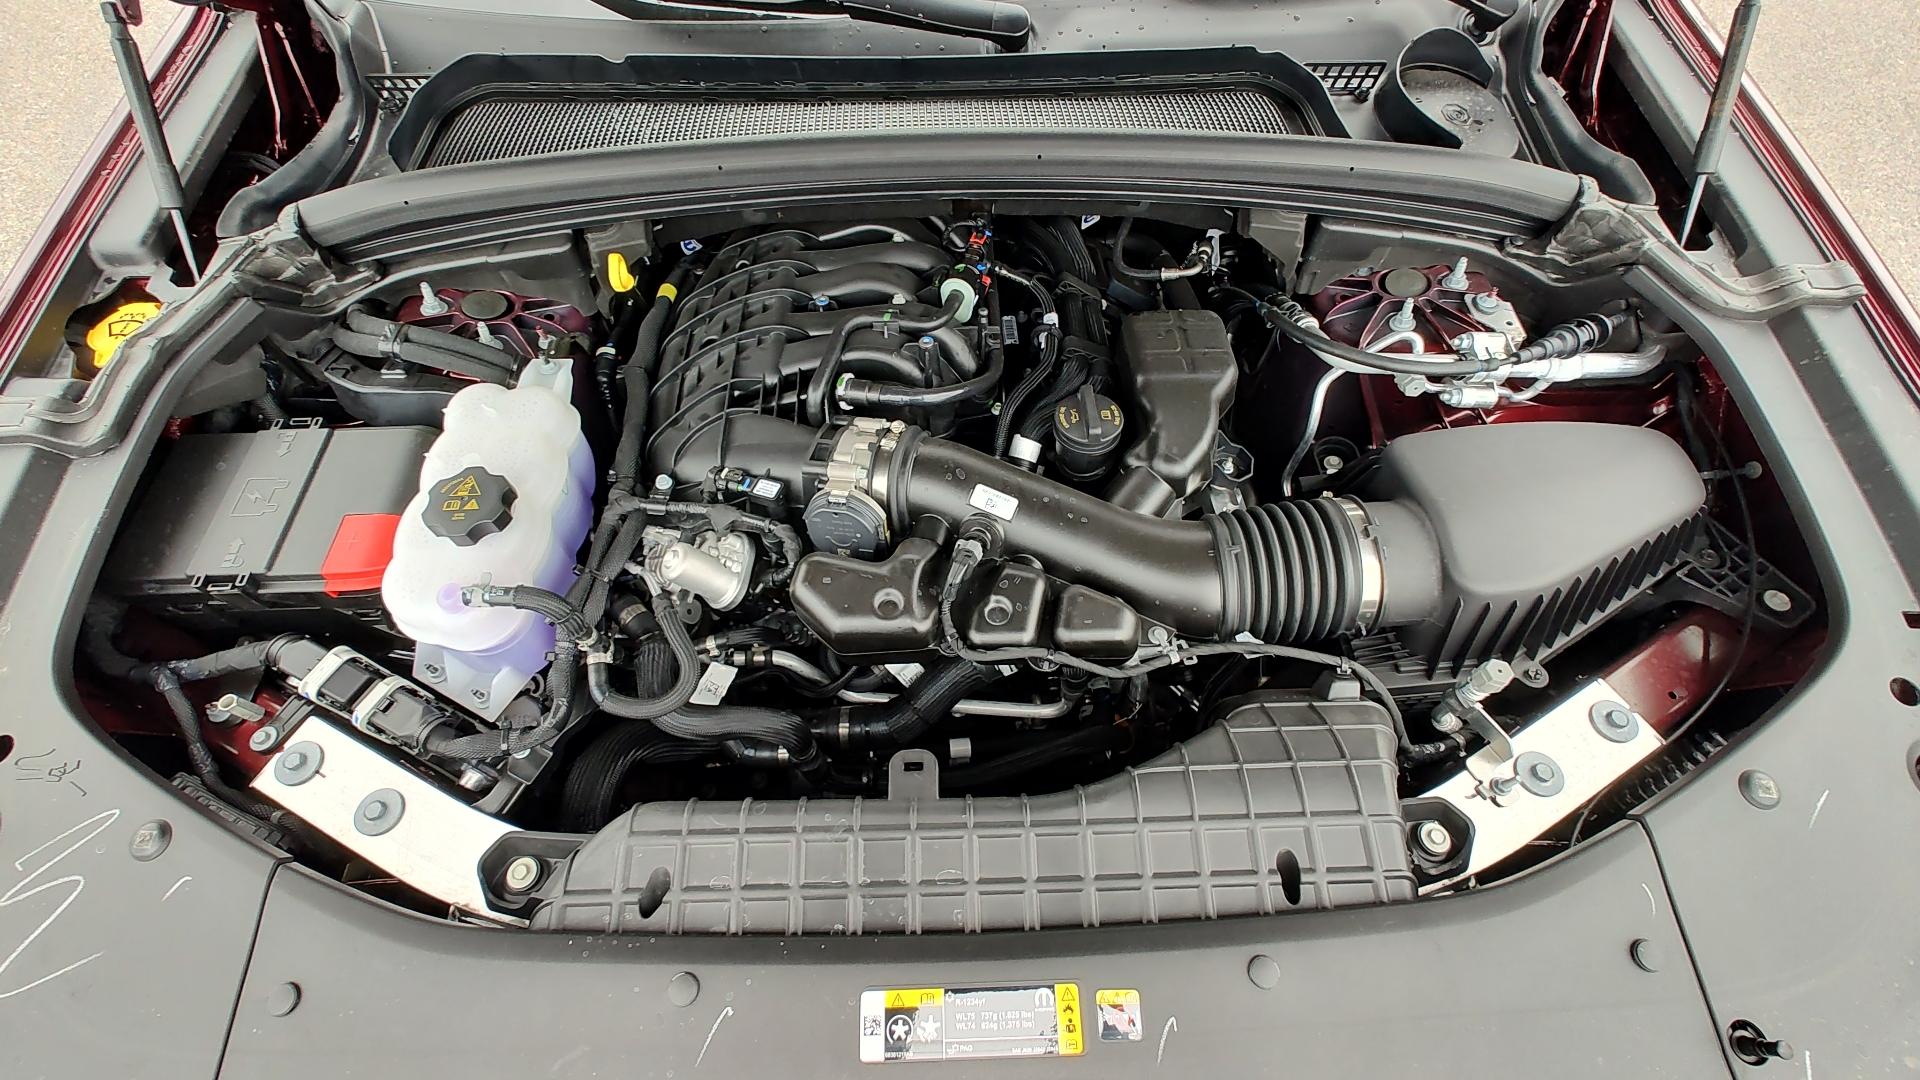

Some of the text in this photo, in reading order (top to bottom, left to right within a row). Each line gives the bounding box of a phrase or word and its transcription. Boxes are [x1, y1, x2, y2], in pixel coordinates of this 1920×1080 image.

[955, 998, 986, 1007] R-1234yf
[955, 1010, 1035, 1021] WL75 737g (1.625 lbs)
[955, 1022, 976, 1030] WL74
[1000, 1021, 1020, 1029] (1.375
[1022, 1020, 1035, 1029] lbs)
